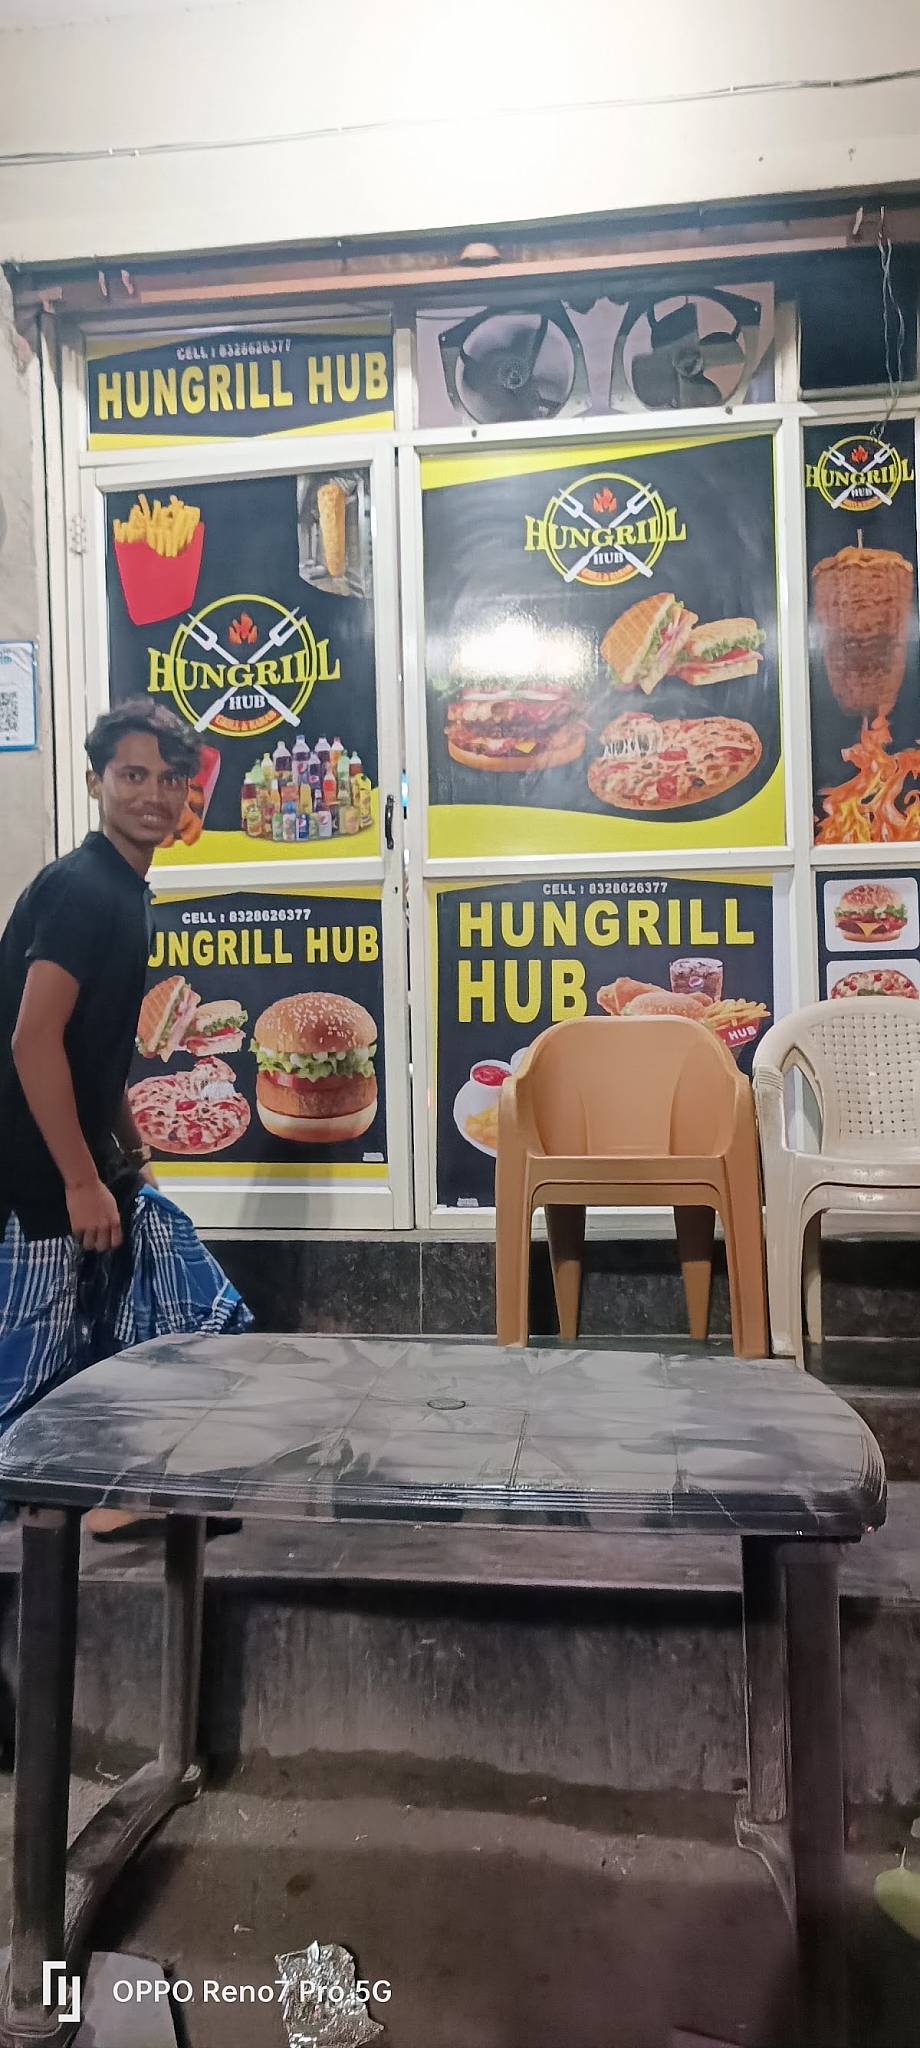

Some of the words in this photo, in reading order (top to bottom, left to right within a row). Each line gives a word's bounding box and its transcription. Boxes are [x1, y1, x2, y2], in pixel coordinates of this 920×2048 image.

[98, 359, 293, 420] HUNGRILL
[308, 352, 388, 404] HUB
[805, 458, 914, 487] HUNGRILL
[524, 506, 687, 551] HUNGRILL
[593, 552, 624, 565] HUB
[147, 638, 341, 692] HUNGRILL
[229, 695, 266, 710] HUB
[543, 883, 576, 895] CELL
[589, 882, 668, 895] 8328626377
[182, 911, 216, 924] CELL
[229, 909, 311, 923] 8328626377
[458, 898, 755, 947] HUNGRILL
[147, 928, 293, 967] UNGRILL
[306, 925, 379, 963] HUB
[458, 959, 588, 1023] HUB
[728, 1026, 757, 1040] HUB
